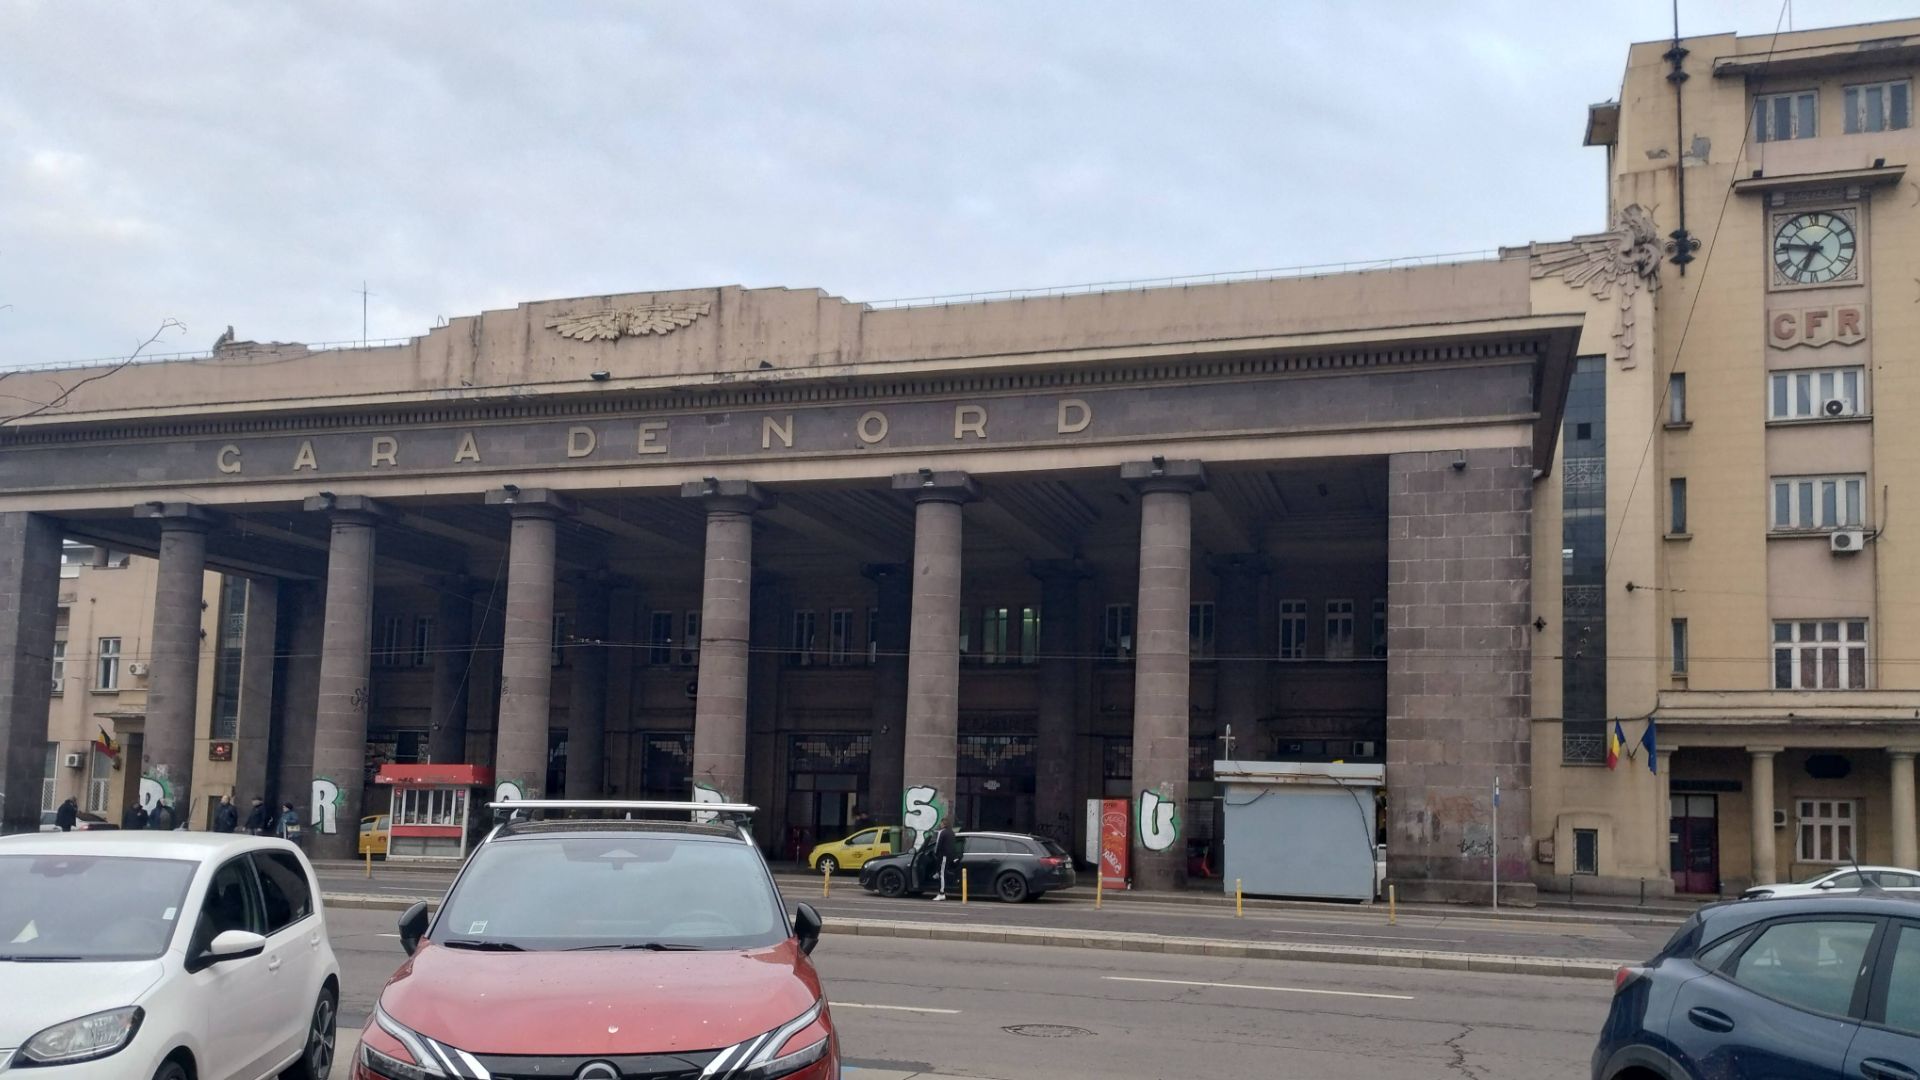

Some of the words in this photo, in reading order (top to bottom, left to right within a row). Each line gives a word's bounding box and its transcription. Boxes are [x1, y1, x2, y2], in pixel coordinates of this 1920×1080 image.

[1773, 308, 1861, 341] CFR
[216, 431, 481, 474] GARA
[567, 421, 669, 458] DE
[761, 399, 1092, 449] NORD
[312, 780, 339, 835] R
